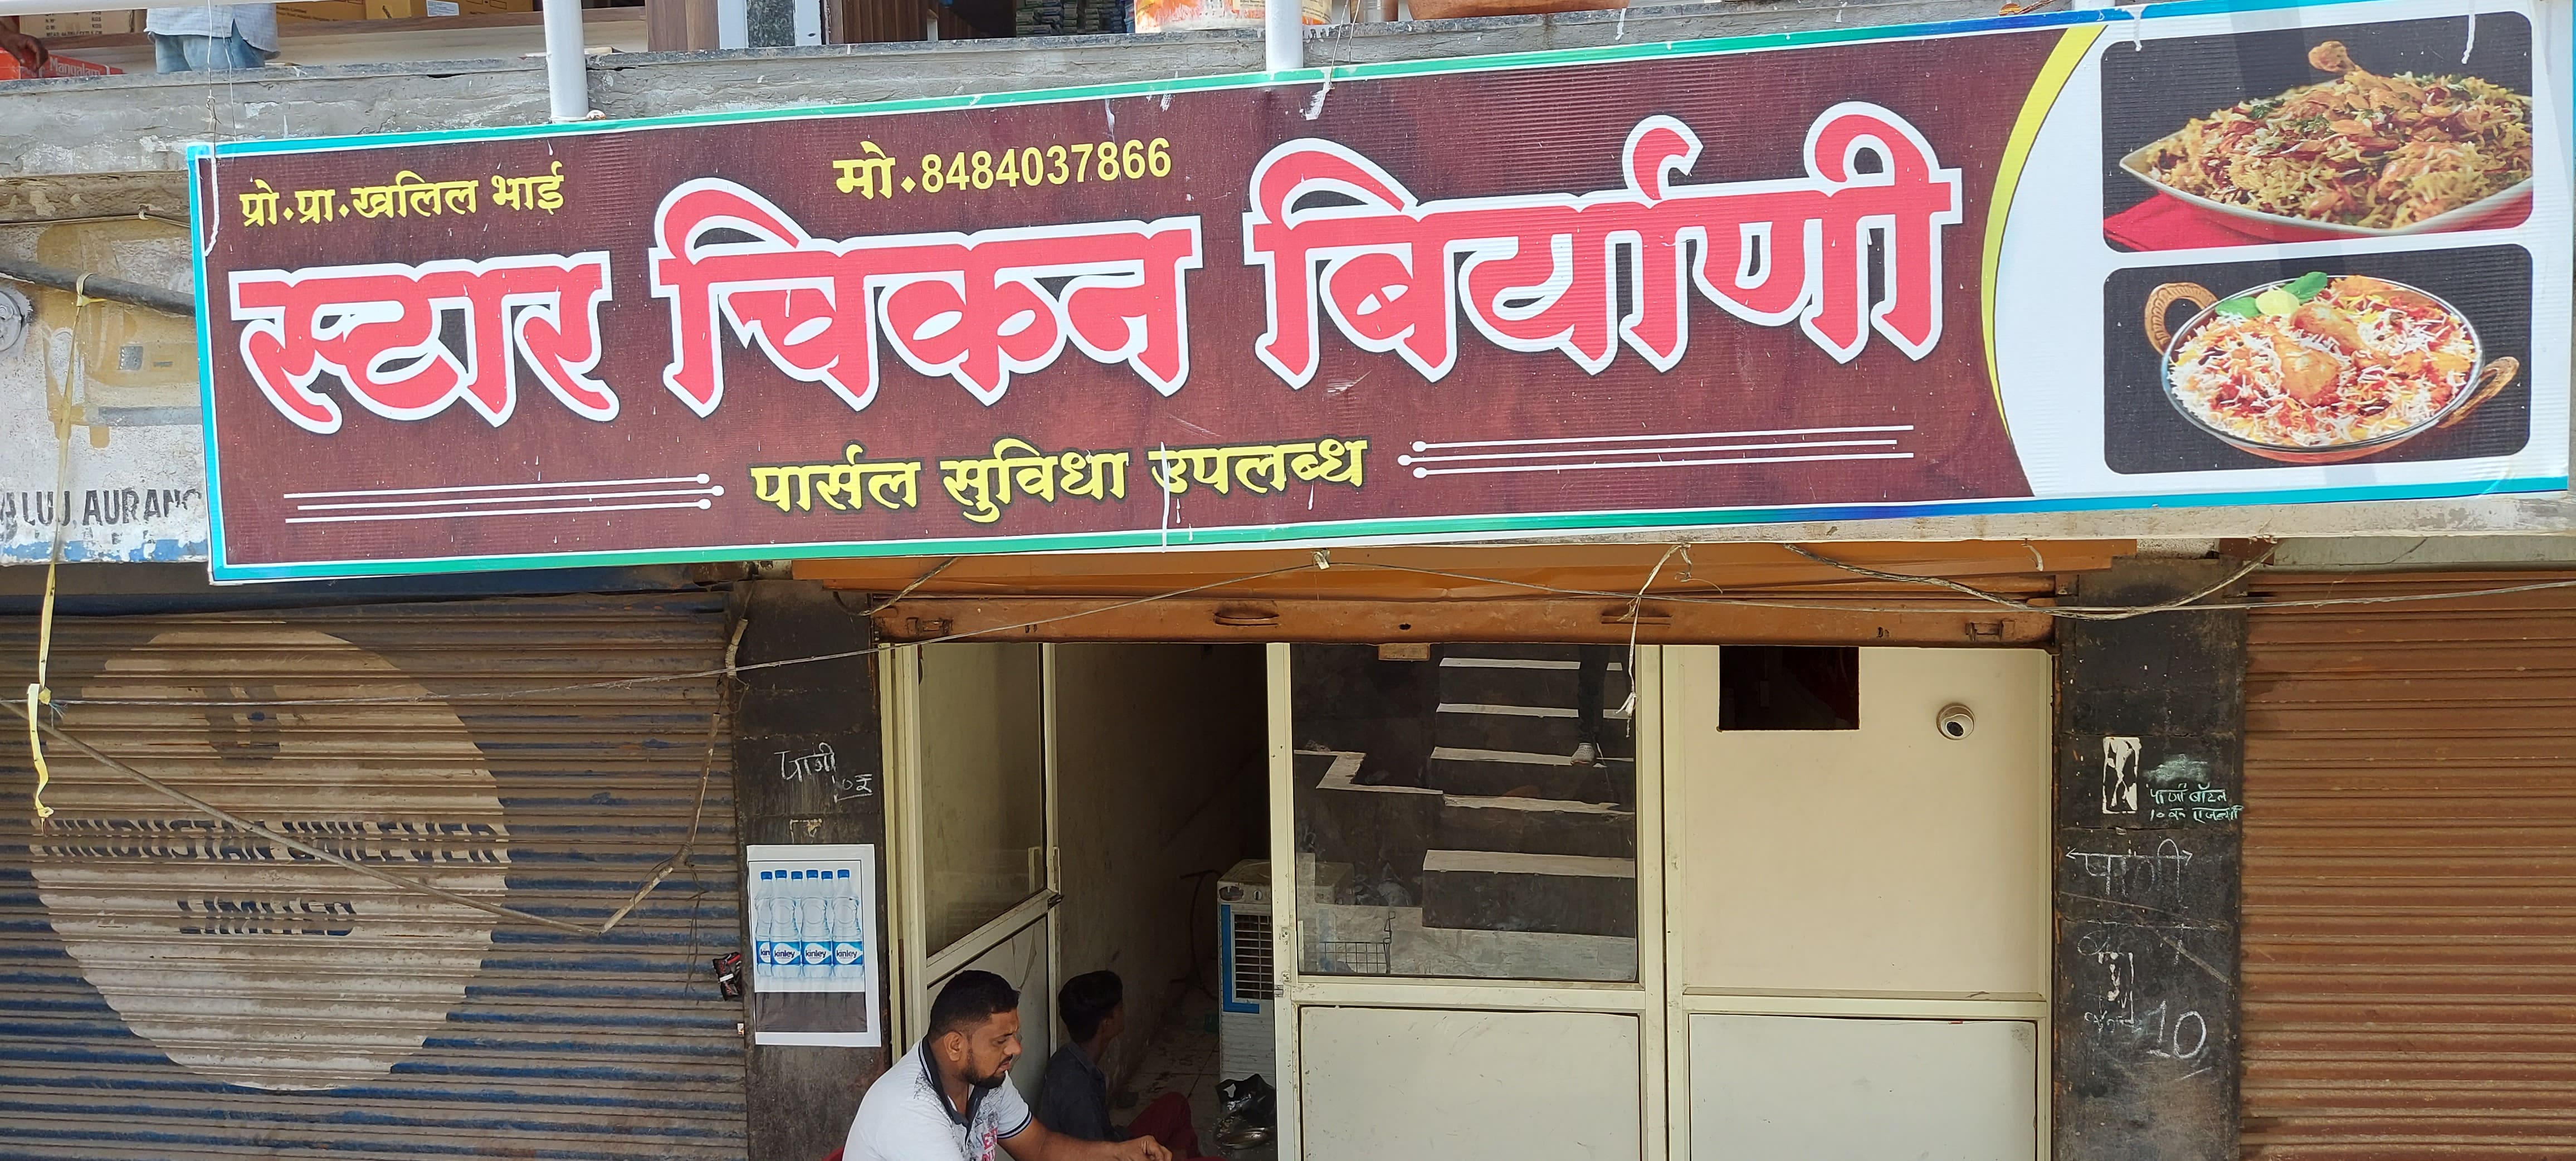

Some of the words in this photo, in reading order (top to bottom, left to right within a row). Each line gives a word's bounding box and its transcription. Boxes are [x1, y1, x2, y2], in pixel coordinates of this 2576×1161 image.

[492, 161, 565, 215] भाई
[228, 251, 619, 435] स्टार
[648, 177, 1203, 418] चिकन
[1243, 101, 1963, 389] बिर्याणी
[750, 443, 921, 513] पार्सल
[940, 437, 1128, 524] सुविधा
[1148, 438, 1367, 495] उपलब्ध
[774, 949, 796, 958] kinley
[805, 949, 826, 958] kinley
[836, 949, 857, 958] kinley
